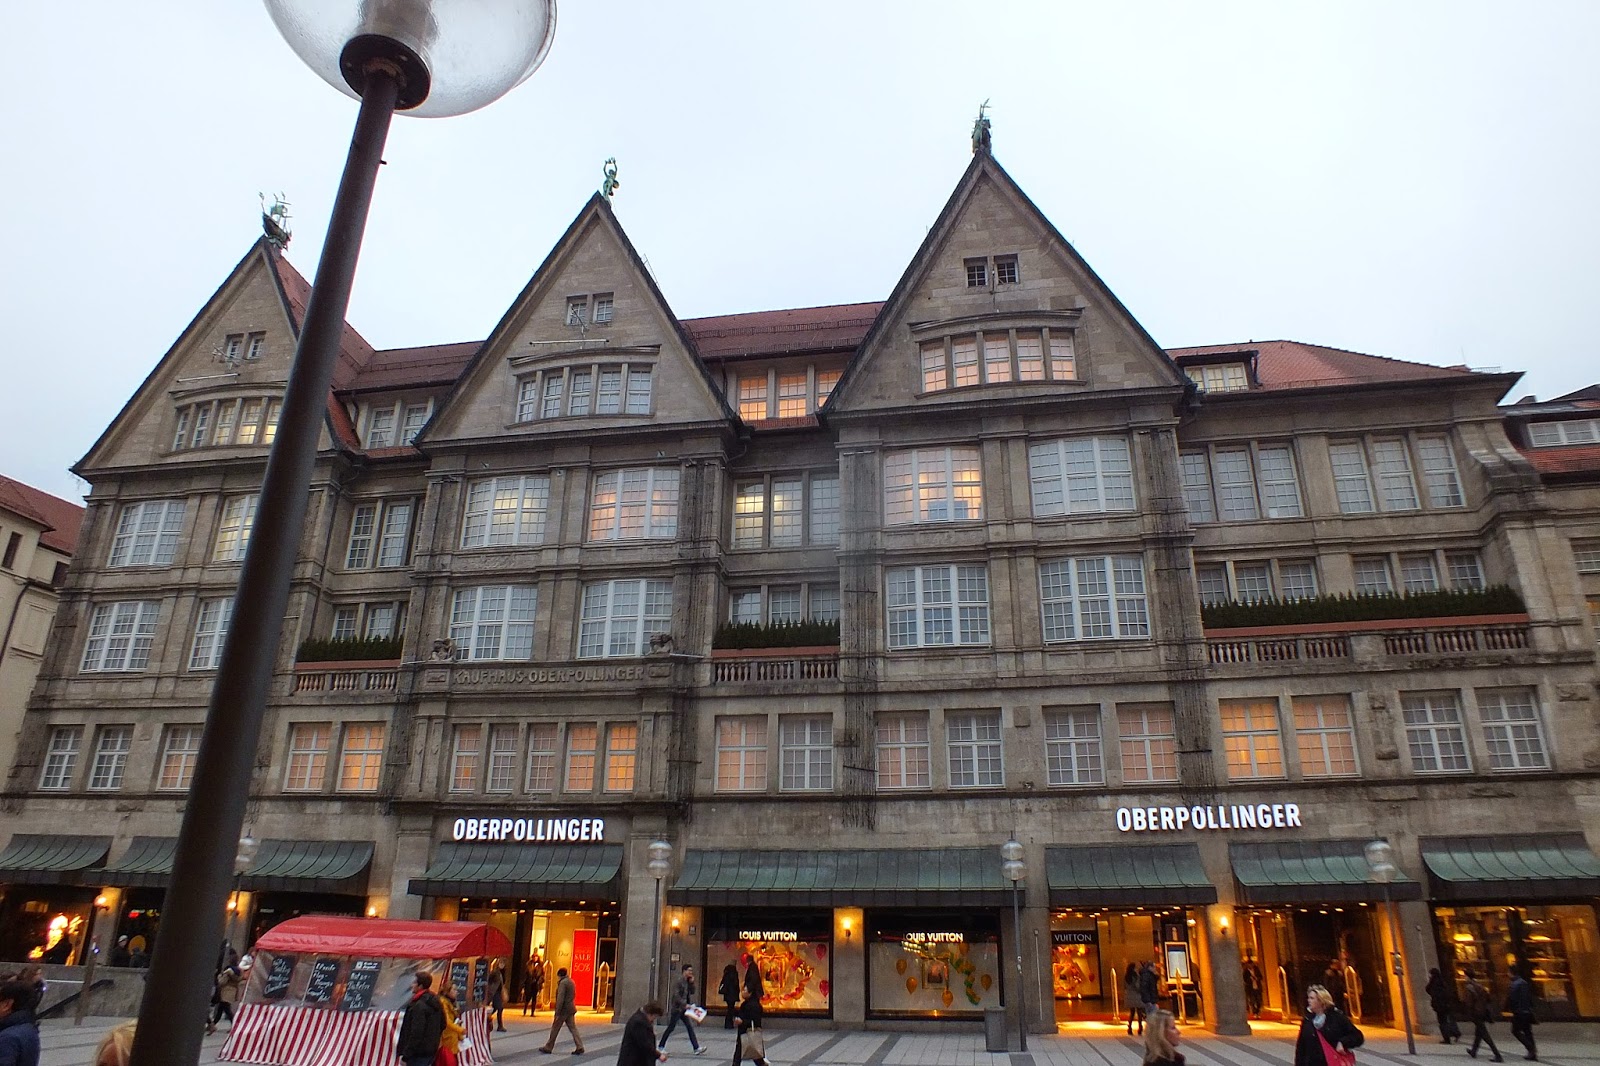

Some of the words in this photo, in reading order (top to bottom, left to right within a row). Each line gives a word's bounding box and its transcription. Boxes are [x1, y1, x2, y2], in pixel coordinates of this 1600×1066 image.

[528, 666, 645, 683] OBERPOLLINGER
[1116, 803, 1302, 832] OBERPOLLINGER
[453, 818, 604, 841] OBERPOLLINGER
[739, 931, 761, 941] LOUIS
[762, 931, 798, 942] VUITTON
[926, 932, 964, 942] VUITTON
[1054, 933, 1092, 942] VUITTON
[574, 953, 592, 961] SALE
